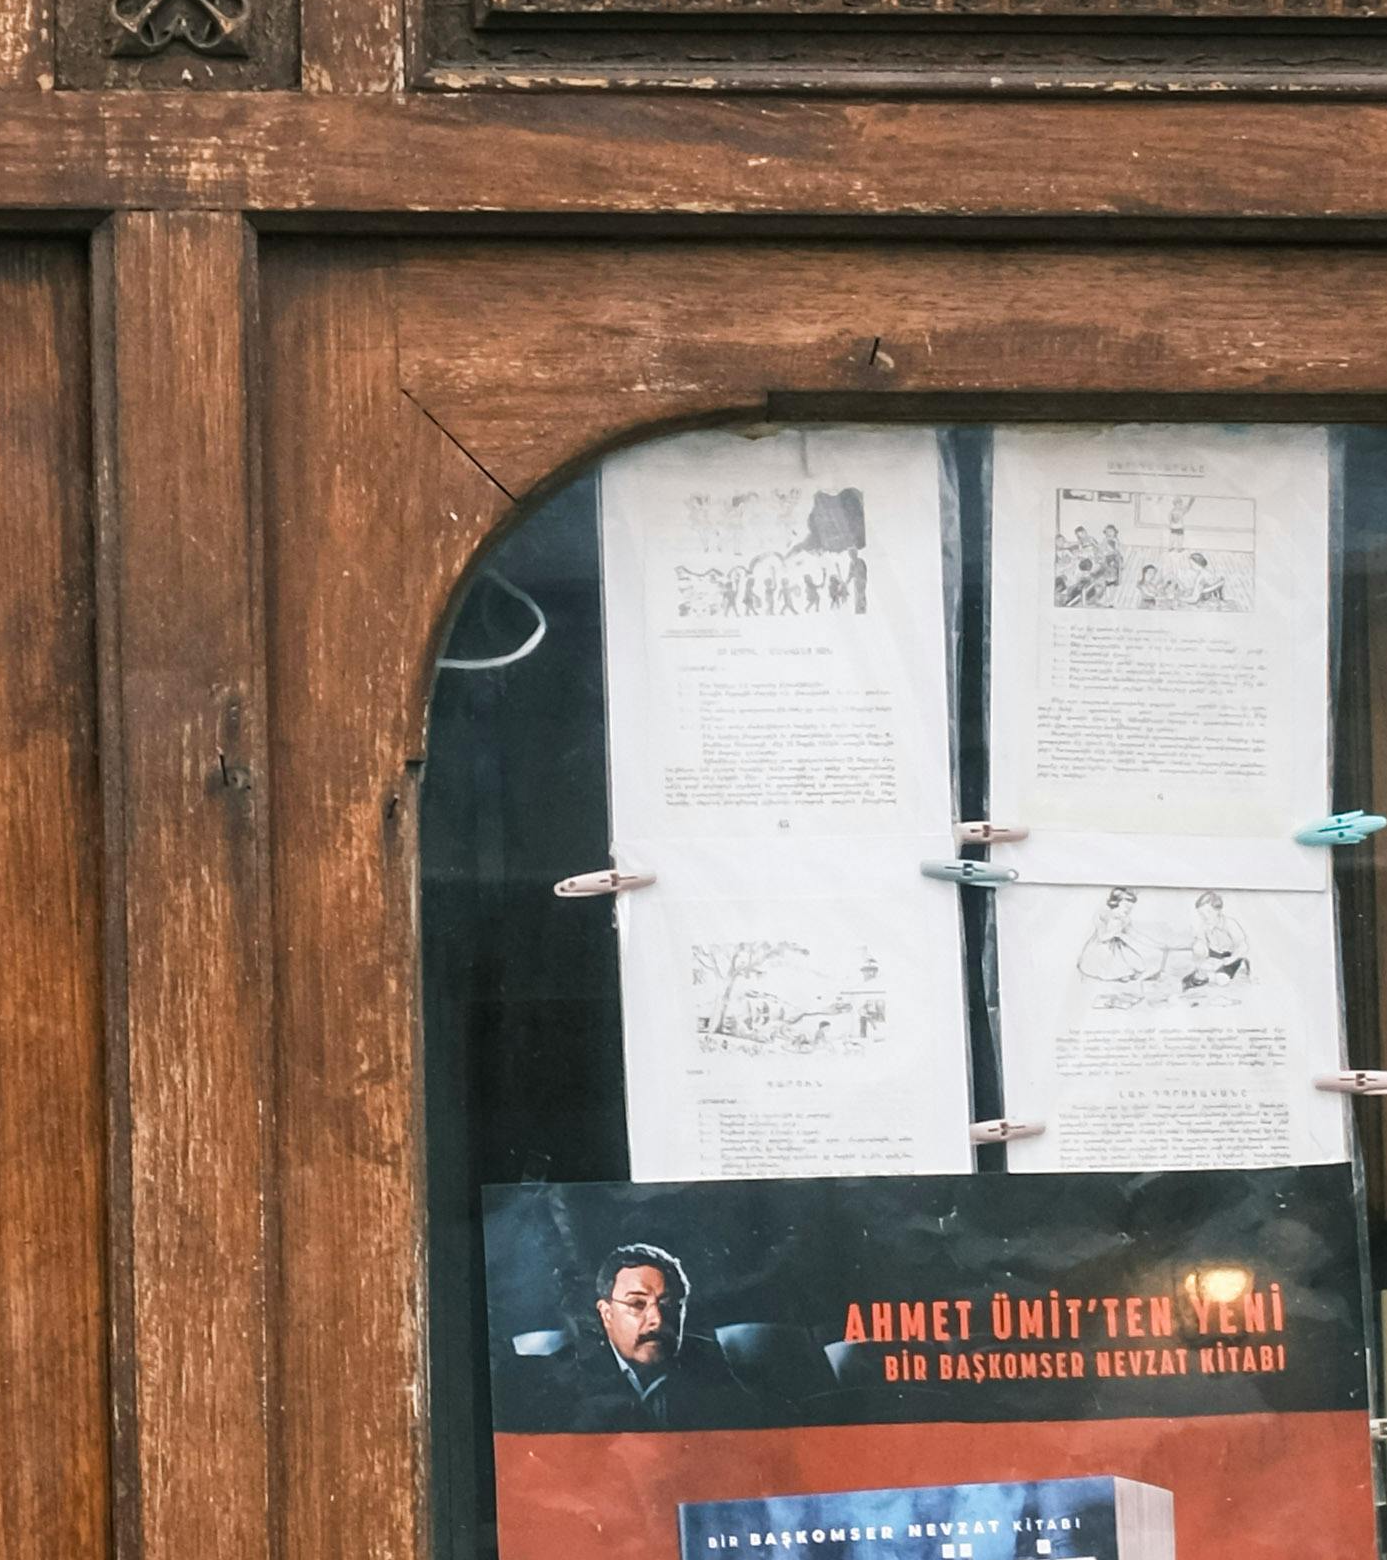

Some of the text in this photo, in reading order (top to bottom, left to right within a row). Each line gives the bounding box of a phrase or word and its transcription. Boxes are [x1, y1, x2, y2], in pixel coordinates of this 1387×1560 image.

[844, 1282, 1286, 1344] AHMET ÜMİT'TEN YENİ
[884, 1343, 1286, 1388] BİR BAŞKOMSER NEVZAT KİTABI
[749, 1526, 894, 1548] BAŞKOMSER
[908, 1519, 1000, 1537] NEVZAT
